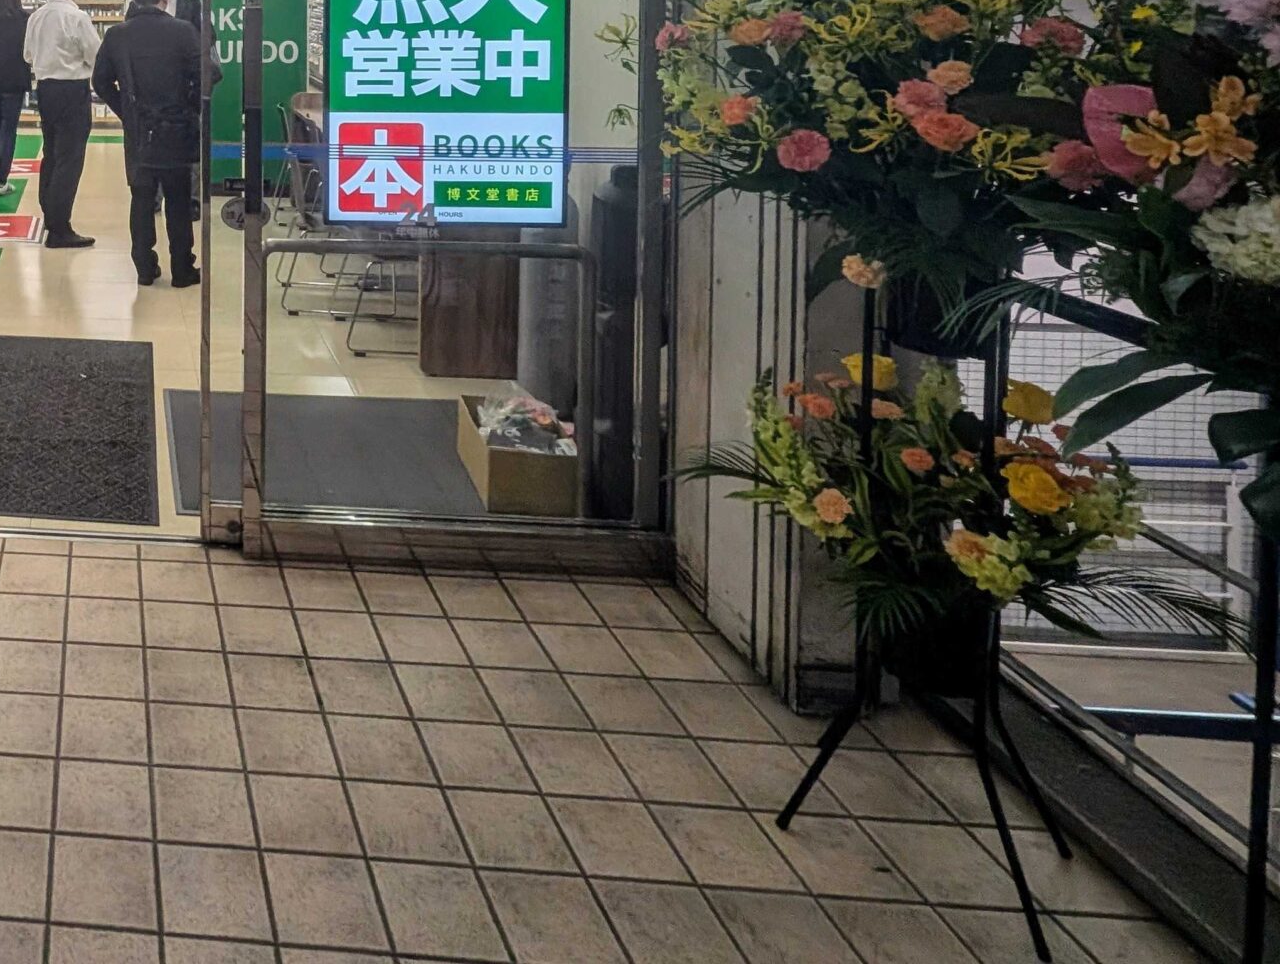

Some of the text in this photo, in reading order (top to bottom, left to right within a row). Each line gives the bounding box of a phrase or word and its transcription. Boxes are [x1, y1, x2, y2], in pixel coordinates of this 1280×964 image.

[342, 29, 551, 98] 営業中
[434, 135, 553, 159] BOOKS
[340, 128, 422, 208] 本
[433, 165, 553, 176] HAKUBUNDO
[446, 188, 540, 202] 博文堂書店
[399, 202, 437, 226] 24
